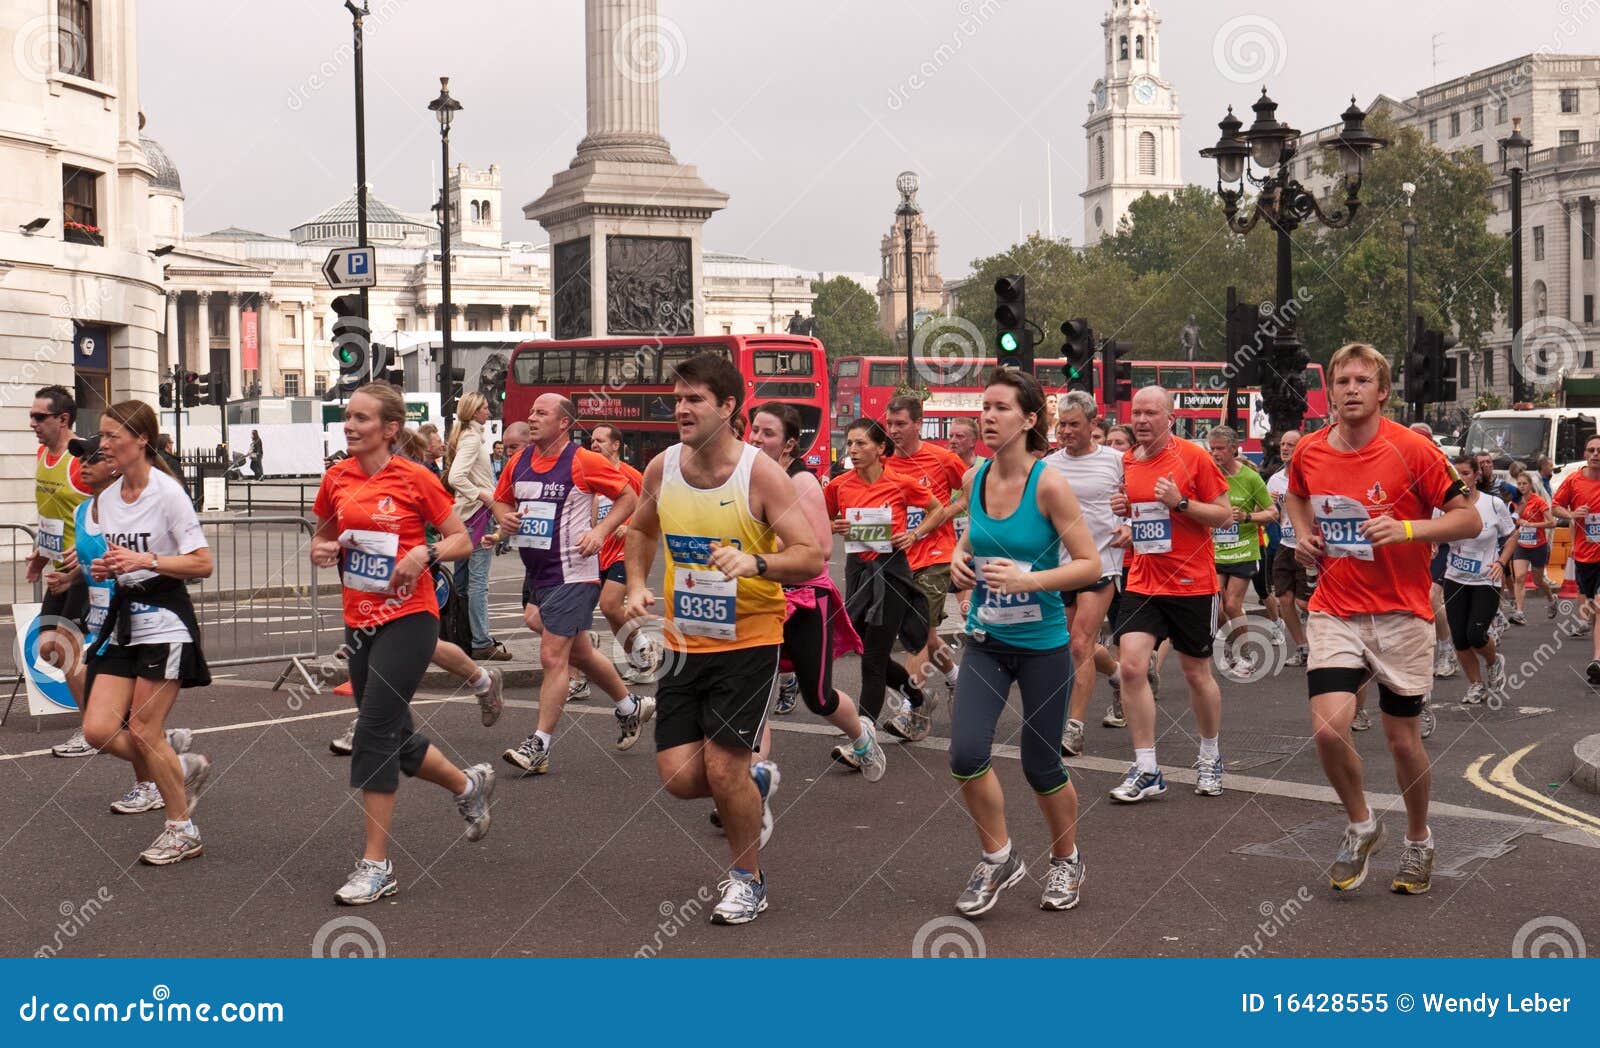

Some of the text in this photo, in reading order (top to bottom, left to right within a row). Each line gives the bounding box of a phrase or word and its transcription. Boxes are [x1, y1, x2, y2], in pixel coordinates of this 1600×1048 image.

[352, 255, 364, 272] P
[544, 482, 565, 491] ndcs
[850, 526, 886, 541] 5772
[1133, 522, 1165, 539] 7388
[350, 551, 389, 578] 9195
[679, 595, 728, 621] 9335
